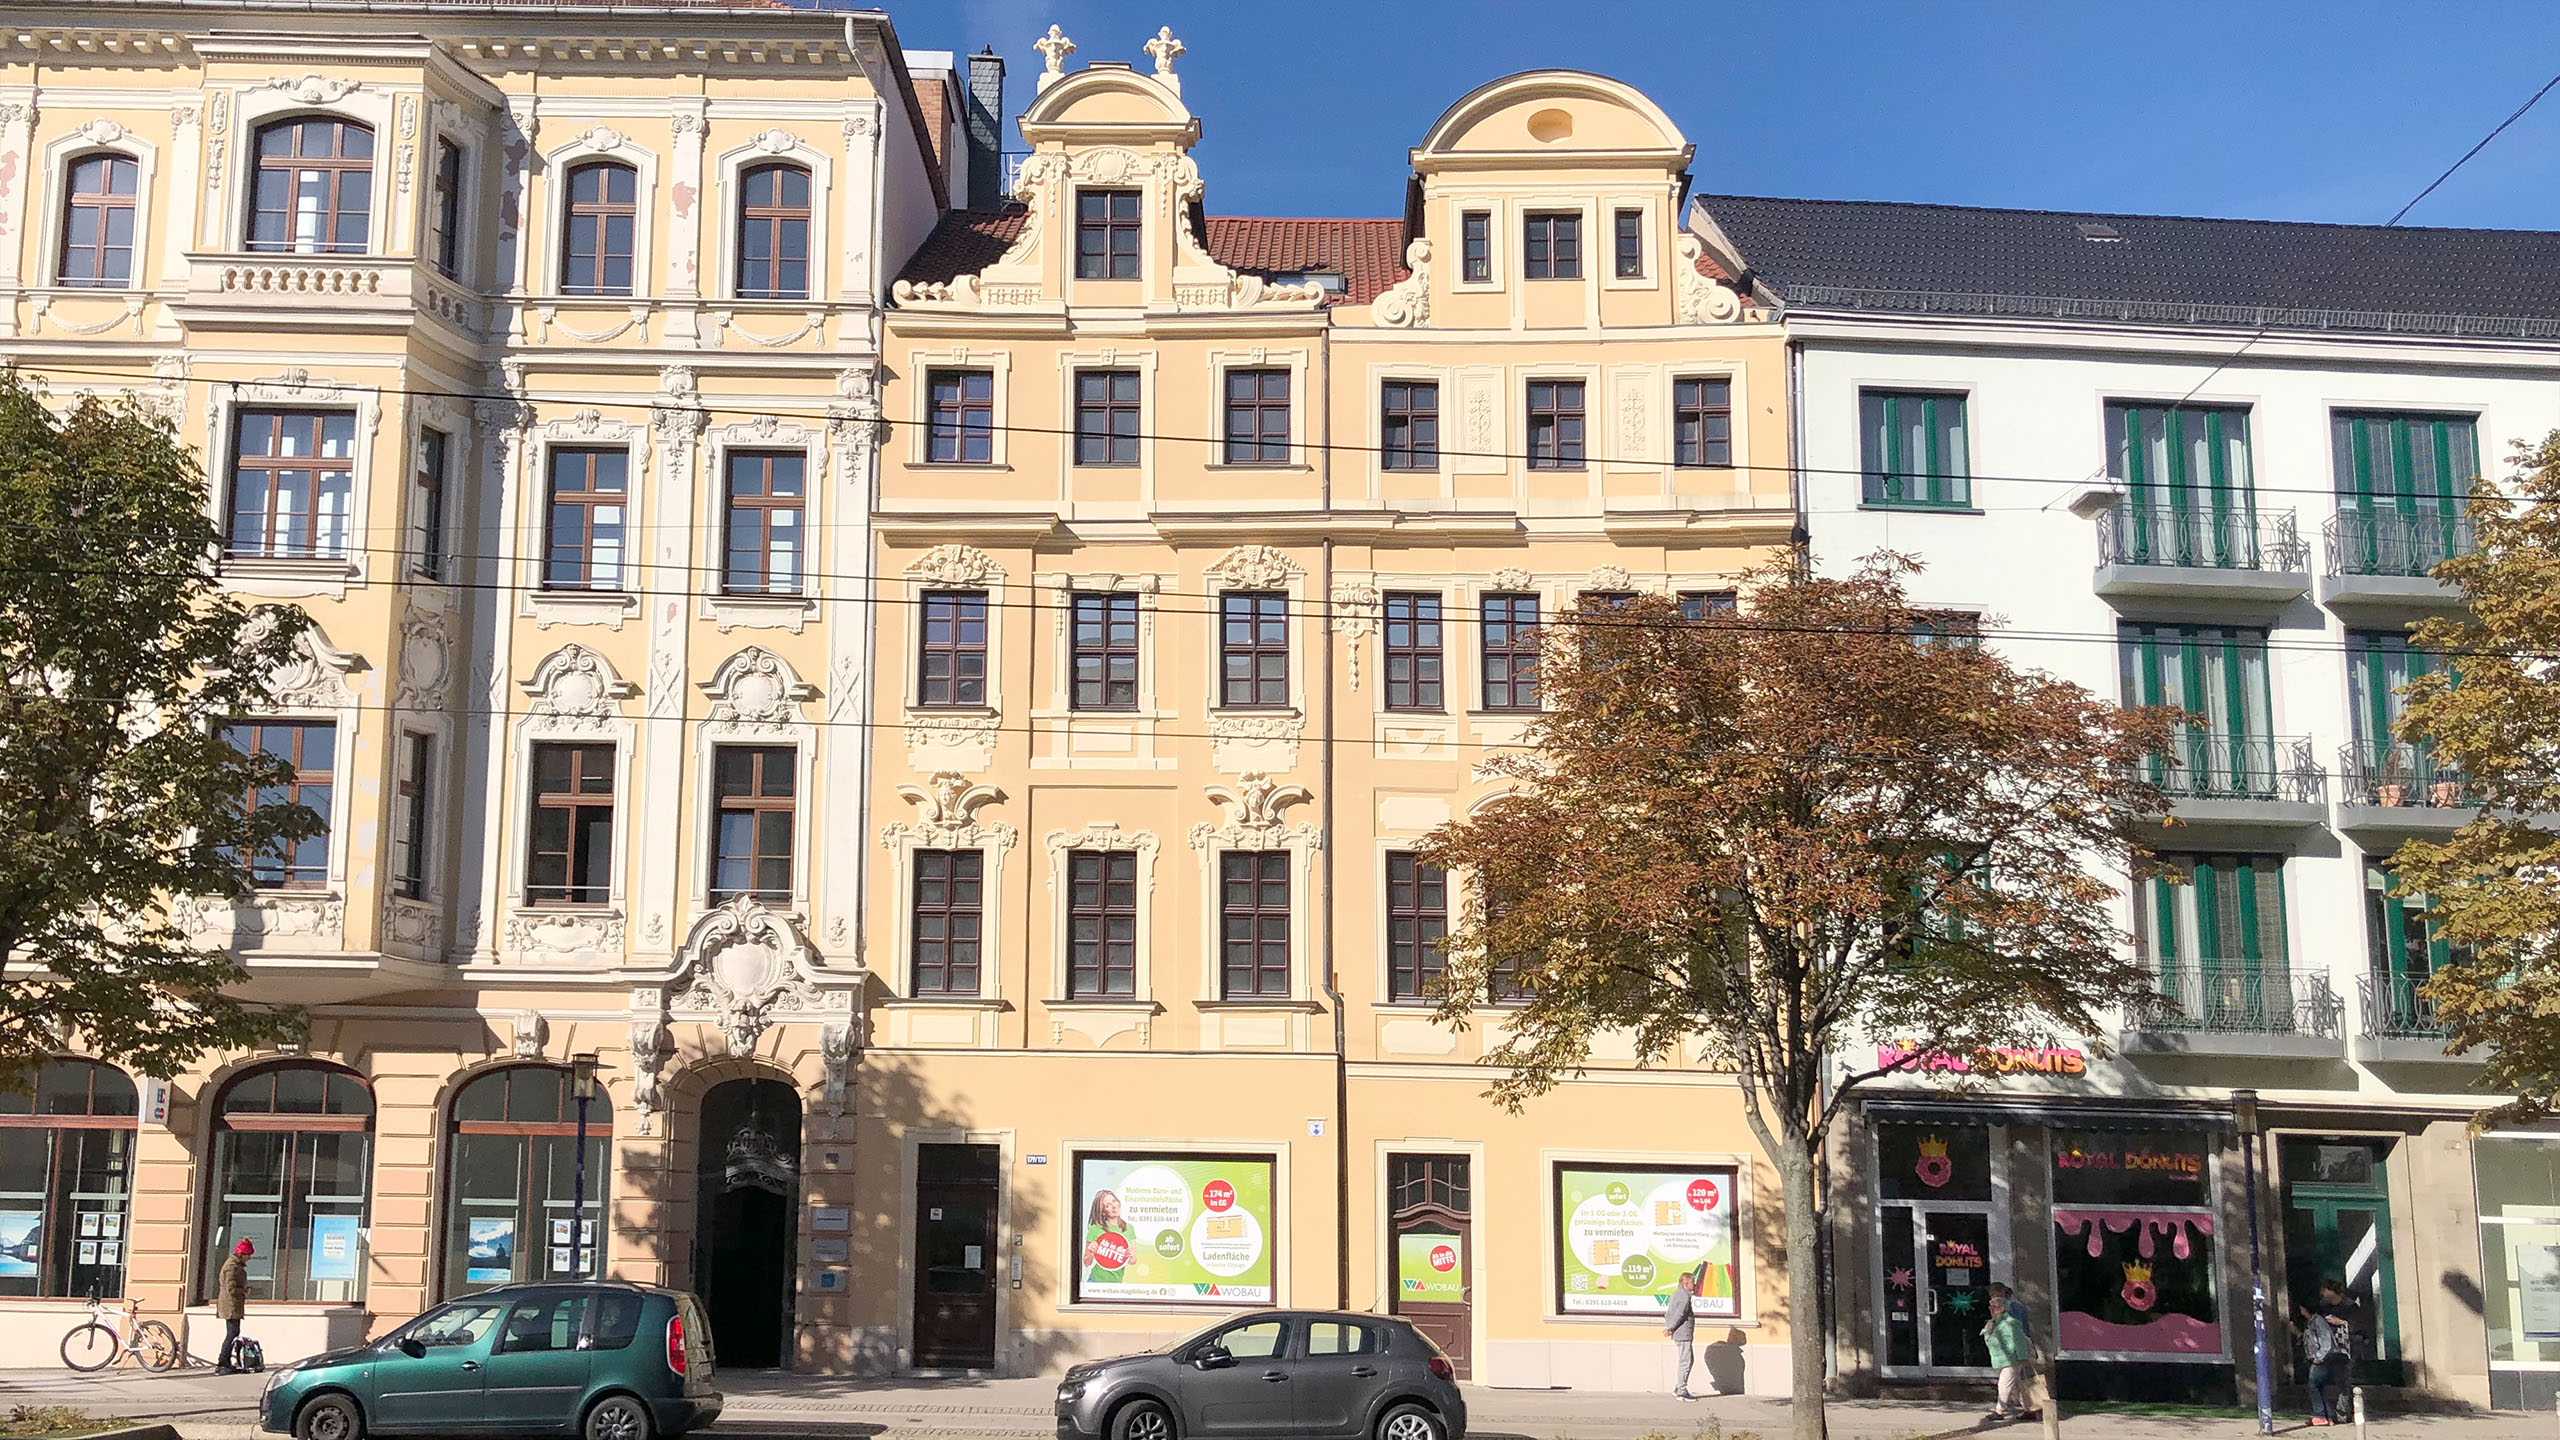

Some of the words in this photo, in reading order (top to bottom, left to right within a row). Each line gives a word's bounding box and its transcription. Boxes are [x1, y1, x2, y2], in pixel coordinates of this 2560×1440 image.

[1878, 1045, 1968, 1071] ROAL
[2059, 1152, 2120, 1169] ROYAL
[2125, 1152, 2201, 1172] DONUTS
[1209, 1190, 1222, 1198] 174
[1692, 1188, 1706, 1197] 120
[1140, 1205, 1178, 1214] vermieten
[1595, 1228, 1634, 1236] vermieten
[1100, 1239, 1110, 1247] Ab
[1165, 1235, 1174, 1243] ab
[1159, 1244, 1180, 1252] sofort
[1939, 1243, 1978, 1256] ROYAL
[1097, 1245, 1126, 1264] MITTE
[1203, 1251, 1250, 1261] Ladenfläche
[1433, 1256, 1455, 1267] MITTE
[1936, 1255, 1982, 1268] DONUTS
[1628, 1264, 1642, 1273] 119
[1426, 1282, 1459, 1291] WOBAU
[1222, 1287, 1261, 1297] WOBAU
[1692, 1298, 1723, 1308] OBAU
